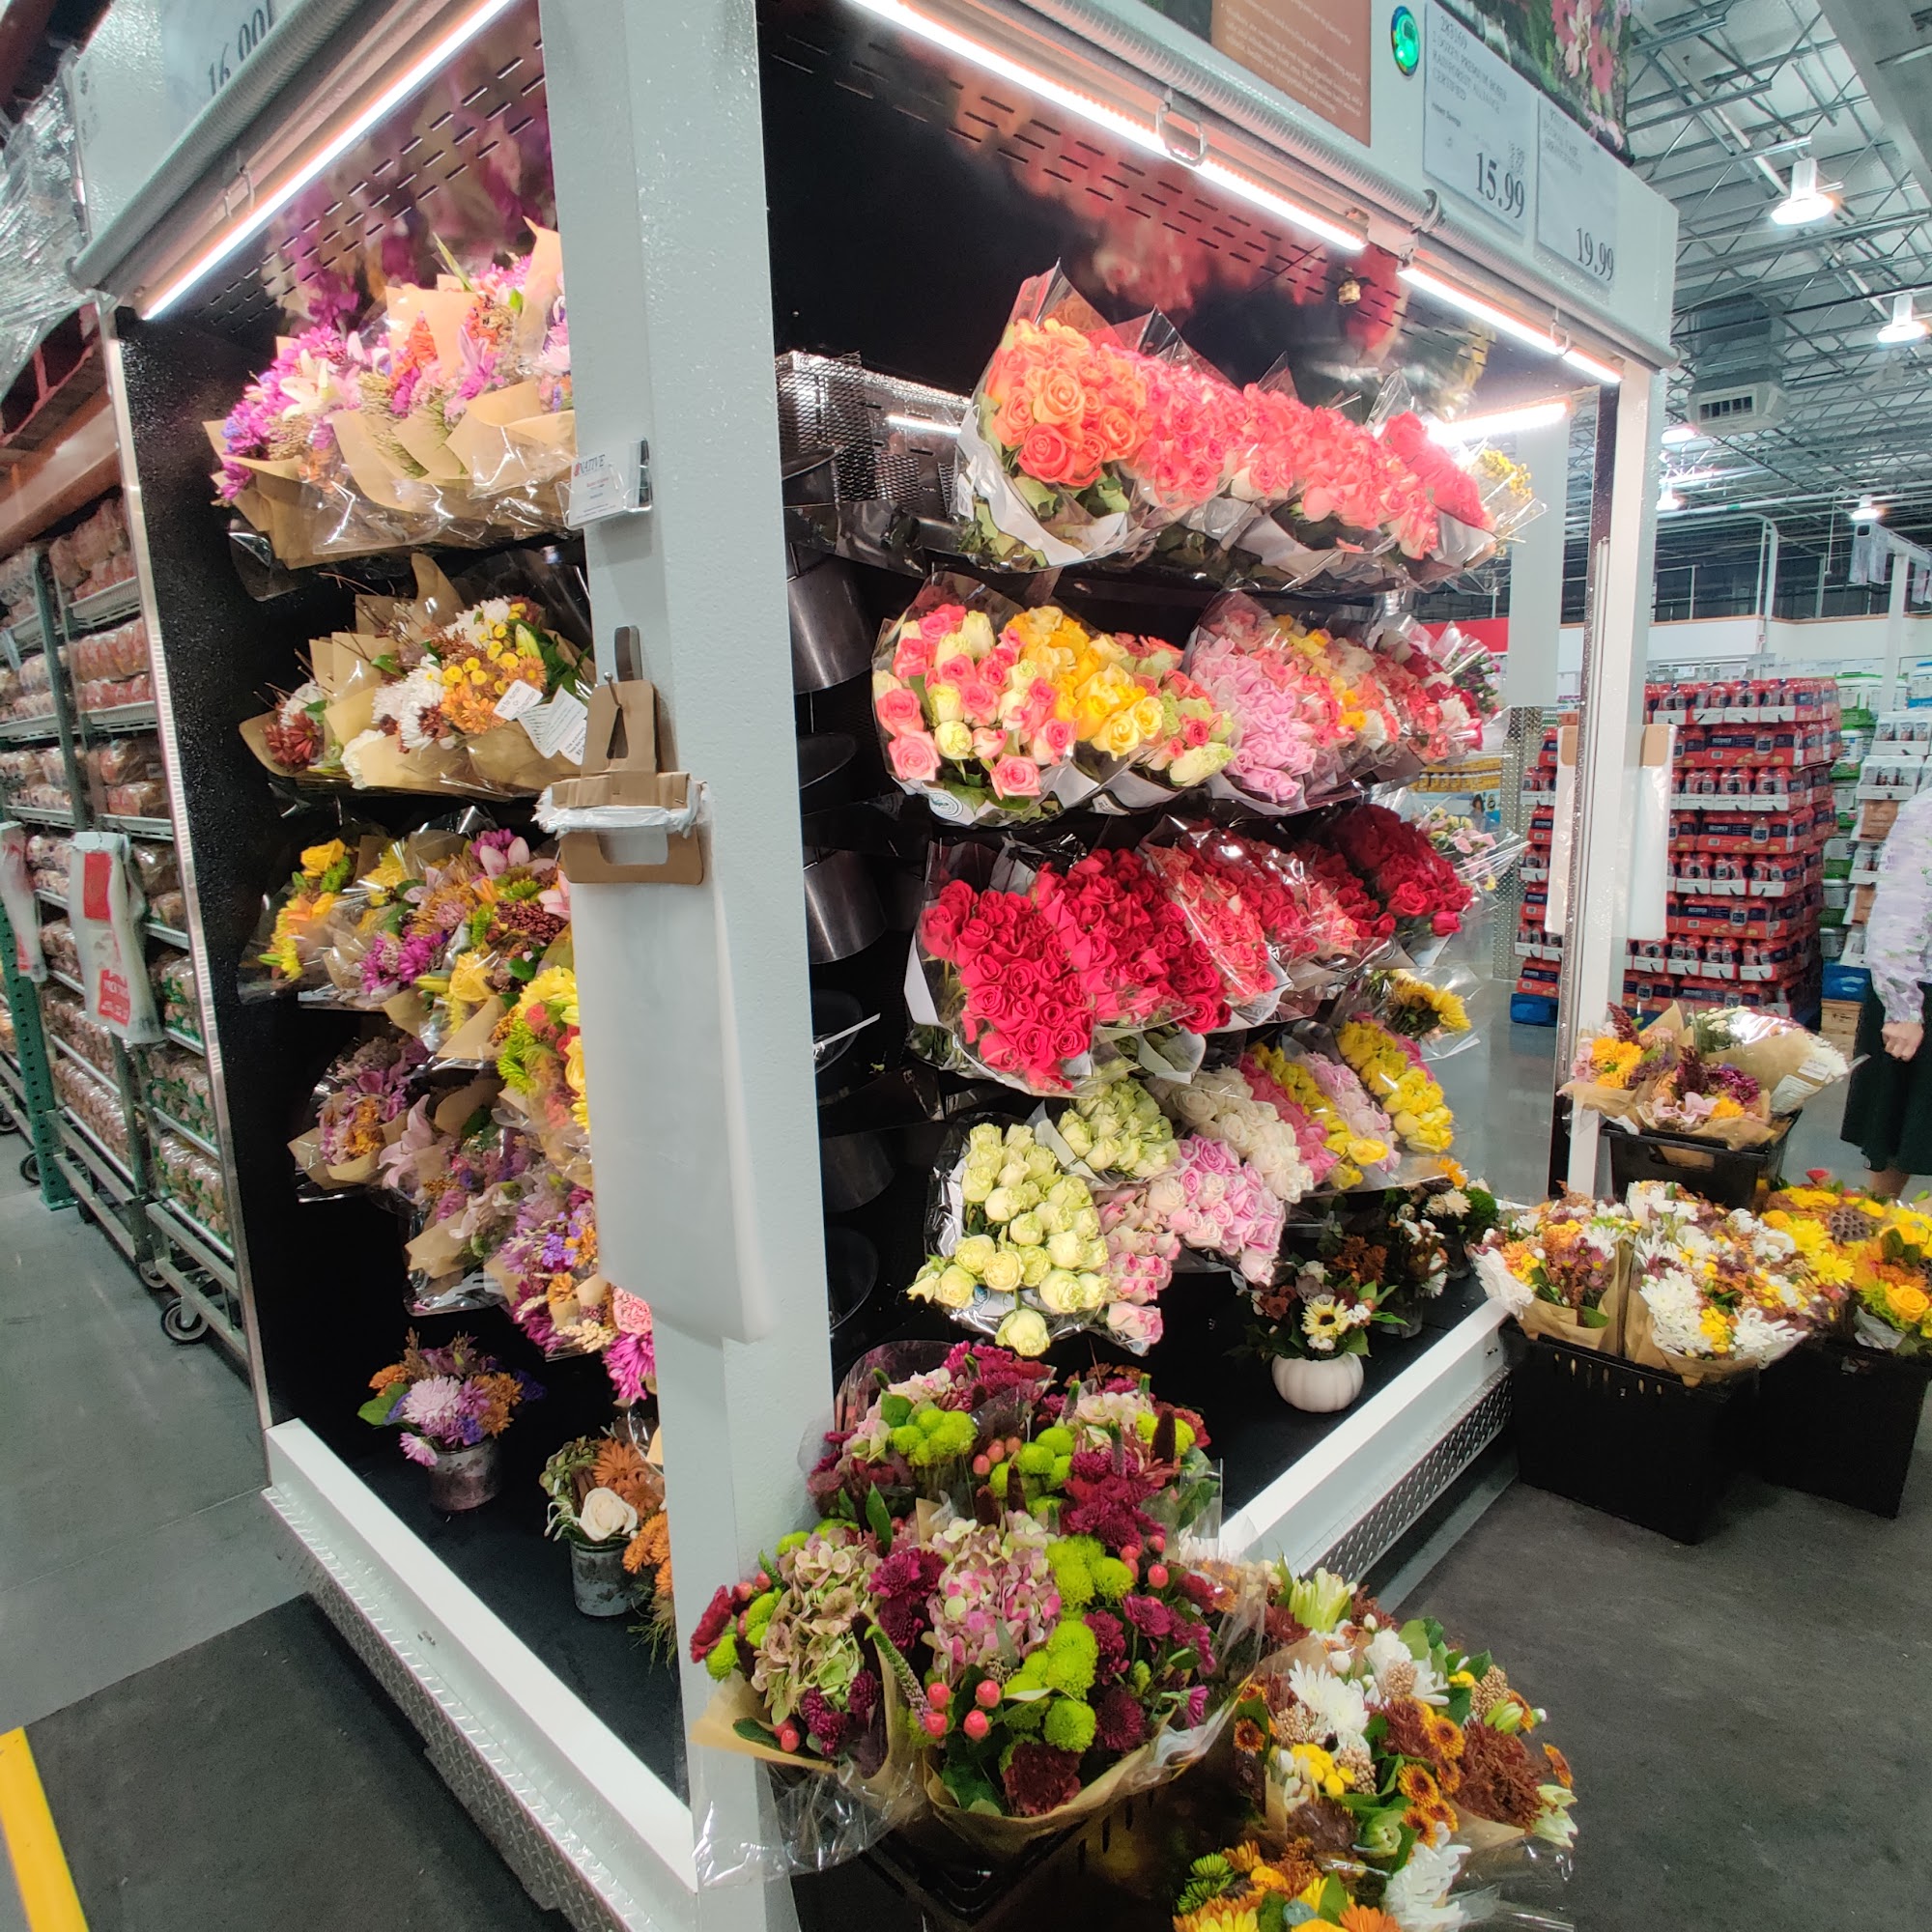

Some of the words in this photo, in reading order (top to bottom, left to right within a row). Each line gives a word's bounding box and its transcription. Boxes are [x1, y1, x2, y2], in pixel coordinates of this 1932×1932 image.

[1476, 152, 1525, 219] 15.99
[1577, 227, 1614, 281] 19.99
[580, 454, 605, 473] NATIVE
